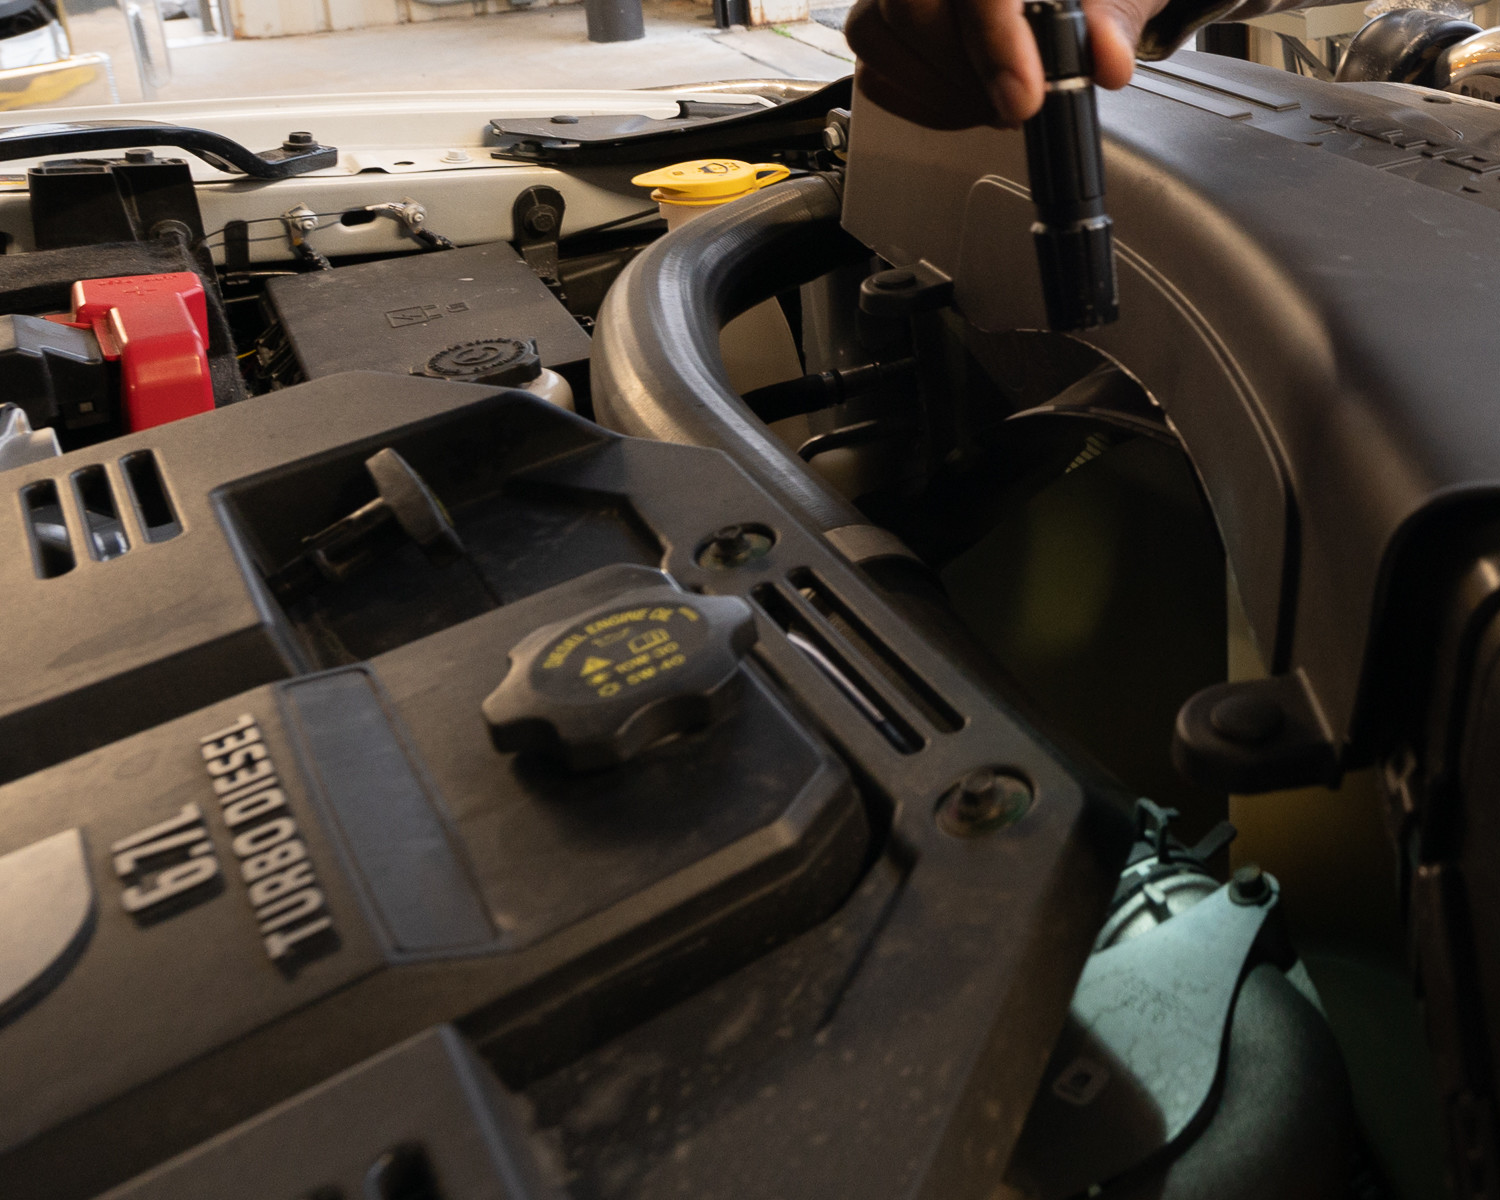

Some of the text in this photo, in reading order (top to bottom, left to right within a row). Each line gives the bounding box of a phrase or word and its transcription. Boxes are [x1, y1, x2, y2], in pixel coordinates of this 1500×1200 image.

[112, 802, 220, 913] 6.7L
[200, 712, 333, 960] TURBO DIESEL
